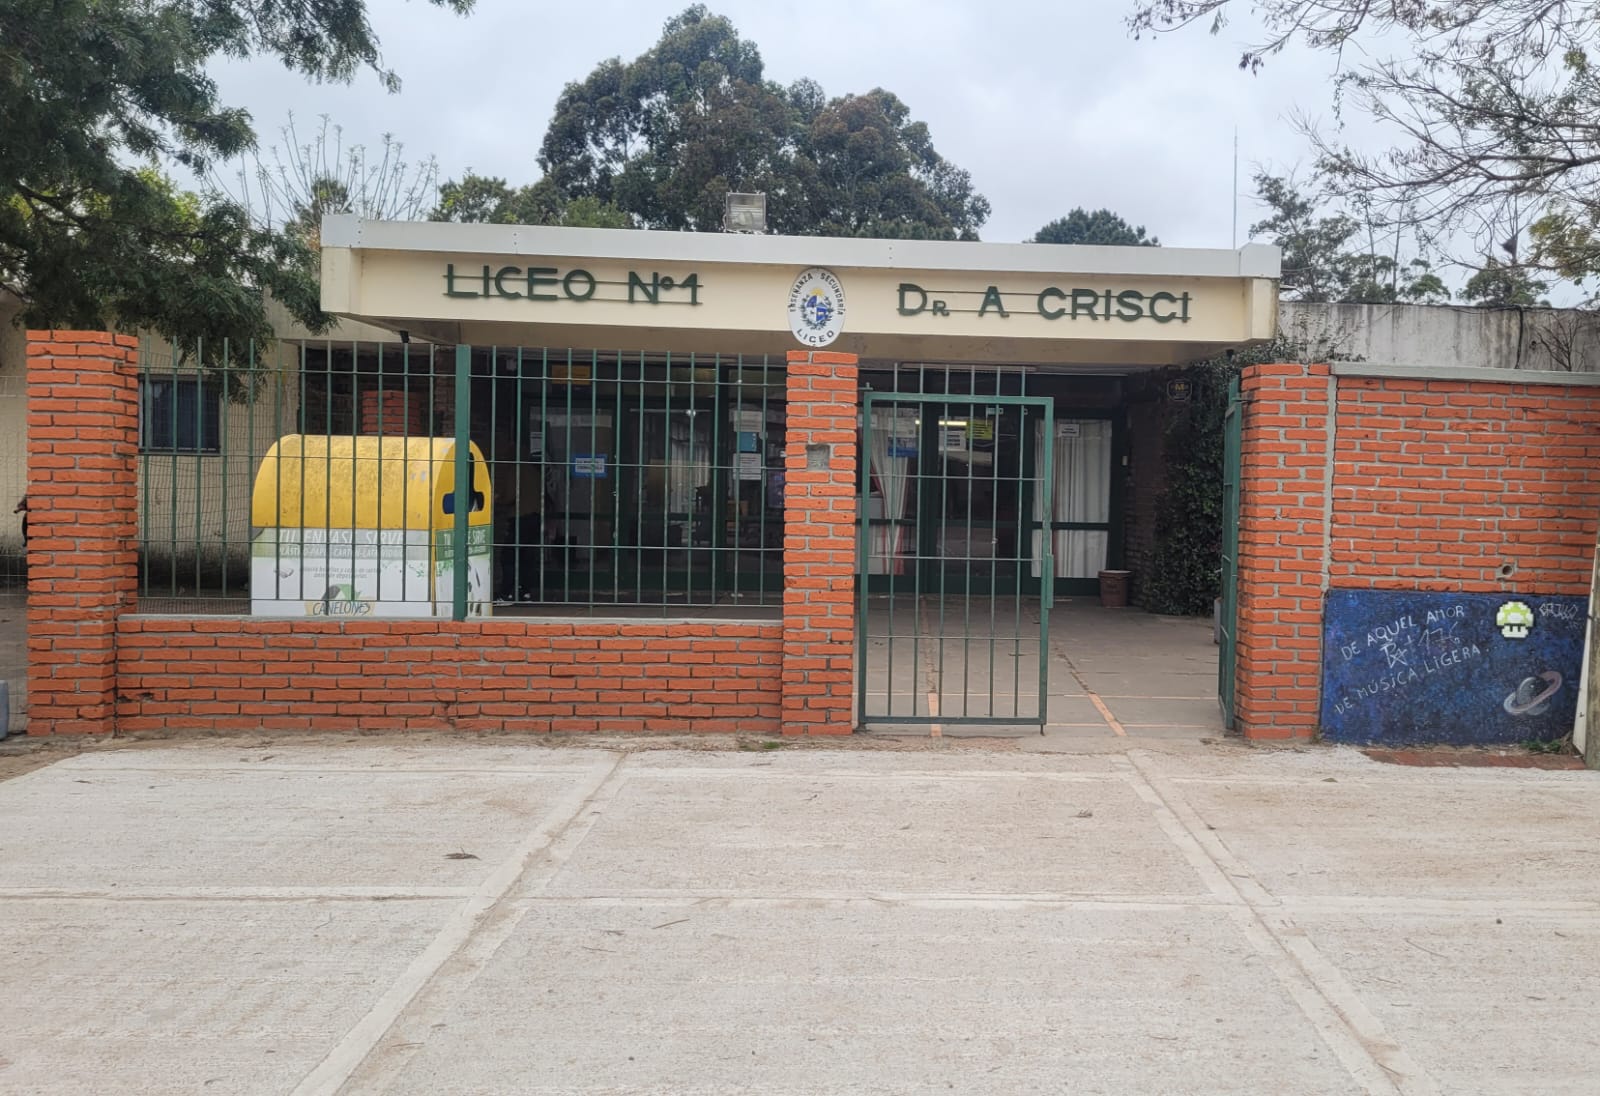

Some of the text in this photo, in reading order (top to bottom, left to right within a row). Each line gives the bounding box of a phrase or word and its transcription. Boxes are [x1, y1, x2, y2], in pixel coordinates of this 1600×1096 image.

[447, 263, 596, 302] LICEO
[978, 285, 1010, 318] A
[1037, 287, 1189, 323] CRISCI
[796, 328, 834, 343] LICEO
[1341, 641, 1361, 661] DE
[1366, 617, 1418, 647] AQUEL
[1426, 605, 1465, 625] AMOR
